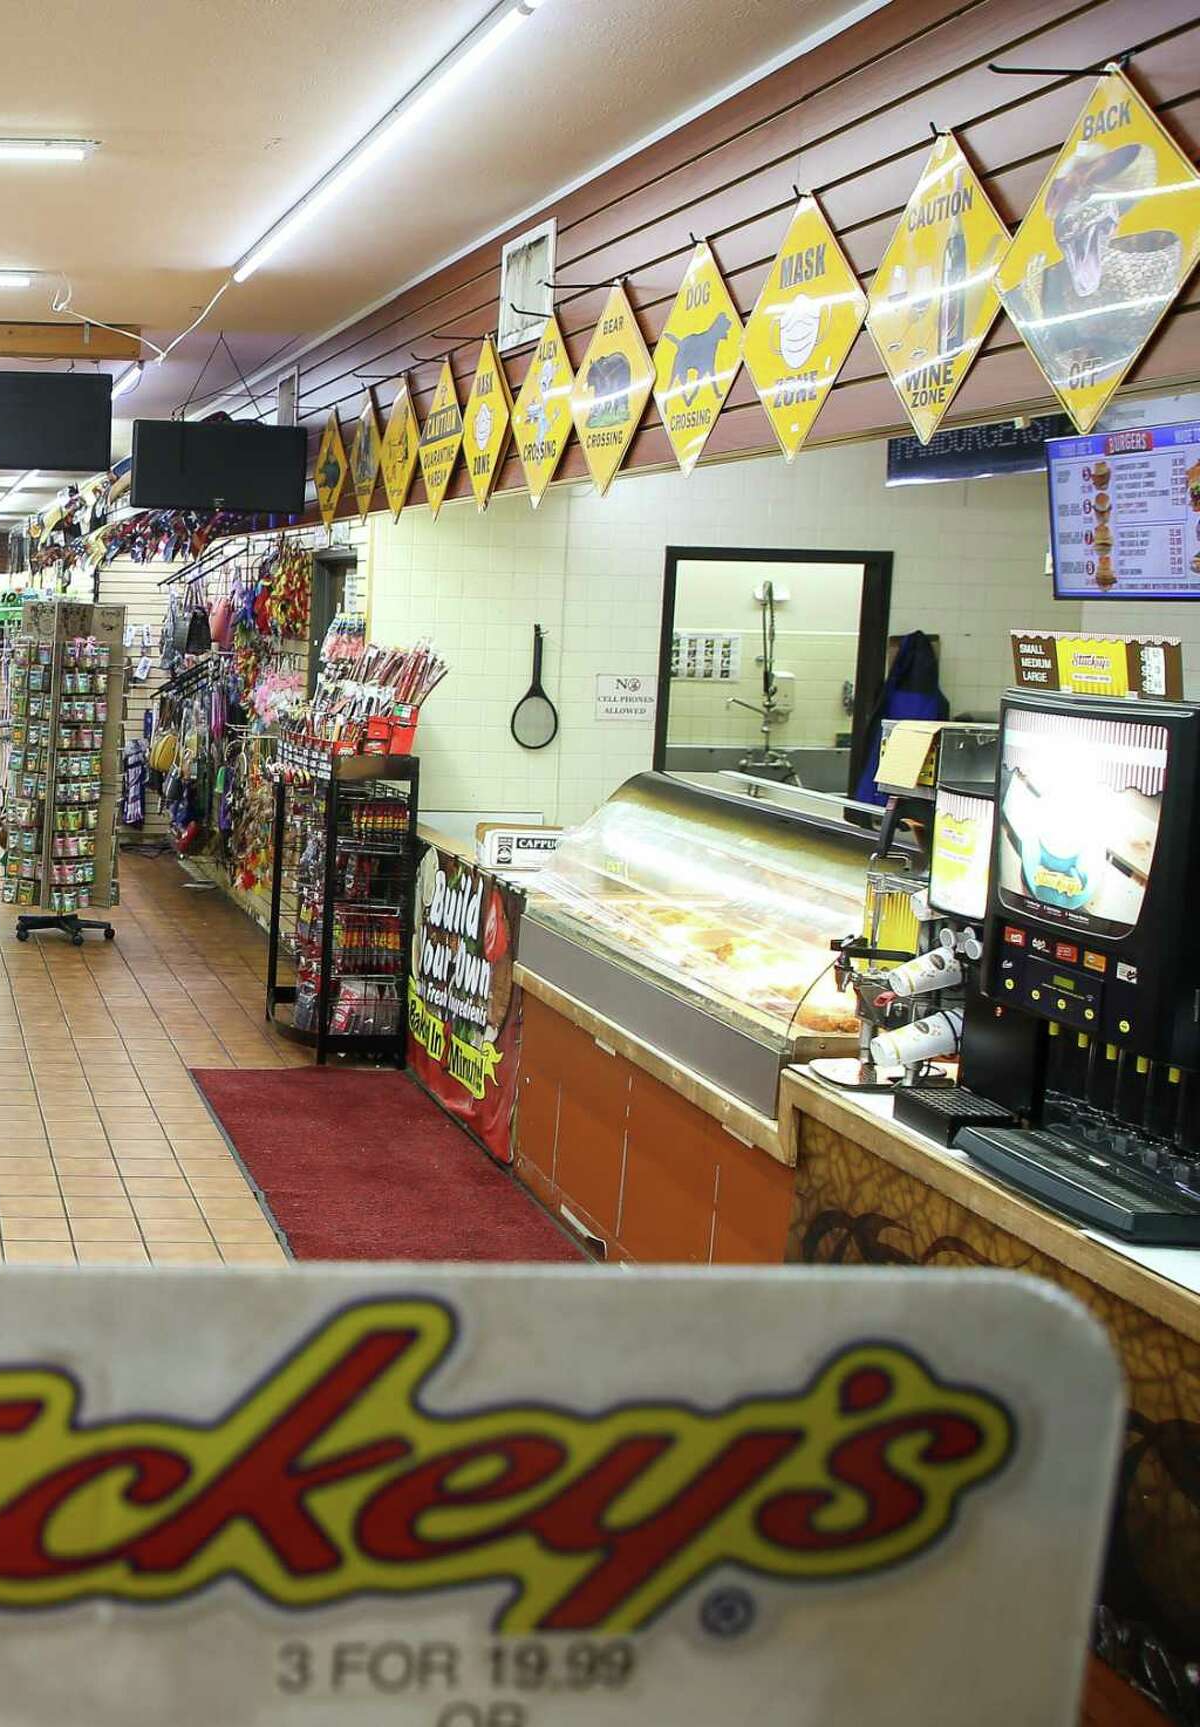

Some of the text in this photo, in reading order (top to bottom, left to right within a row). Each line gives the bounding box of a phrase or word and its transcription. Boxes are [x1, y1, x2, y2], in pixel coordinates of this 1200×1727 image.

[1082, 100, 1132, 142] BACK
[906, 187, 974, 231] CAUTION
[779, 243, 827, 289] MASK
[685, 281, 711, 311] DOG
[602, 316, 625, 336] BEAR
[904, 361, 954, 391] WINE
[1068, 356, 1099, 390] OFF
[773, 370, 819, 409] ZONE
[910, 386, 946, 409] ZONE
[669, 407, 711, 433] CROSSING
[523, 439, 557, 463] CROSSING
[586, 431, 624, 450] CROSSING
[1108, 432, 1148, 453] BURGERS
[1019, 643, 1045, 656] SMALL
[1021, 657, 1052, 669] MEDIUM
[1022, 671, 1049, 683] LARGE
[598, 695, 655, 703] CELL PHONES
[605, 706, 647, 715] ALLOWED
[429, 868, 484, 940] Build
[455, 937, 492, 1001] Own
[277, 1640, 637, 1694] 3 FOR 19.99
